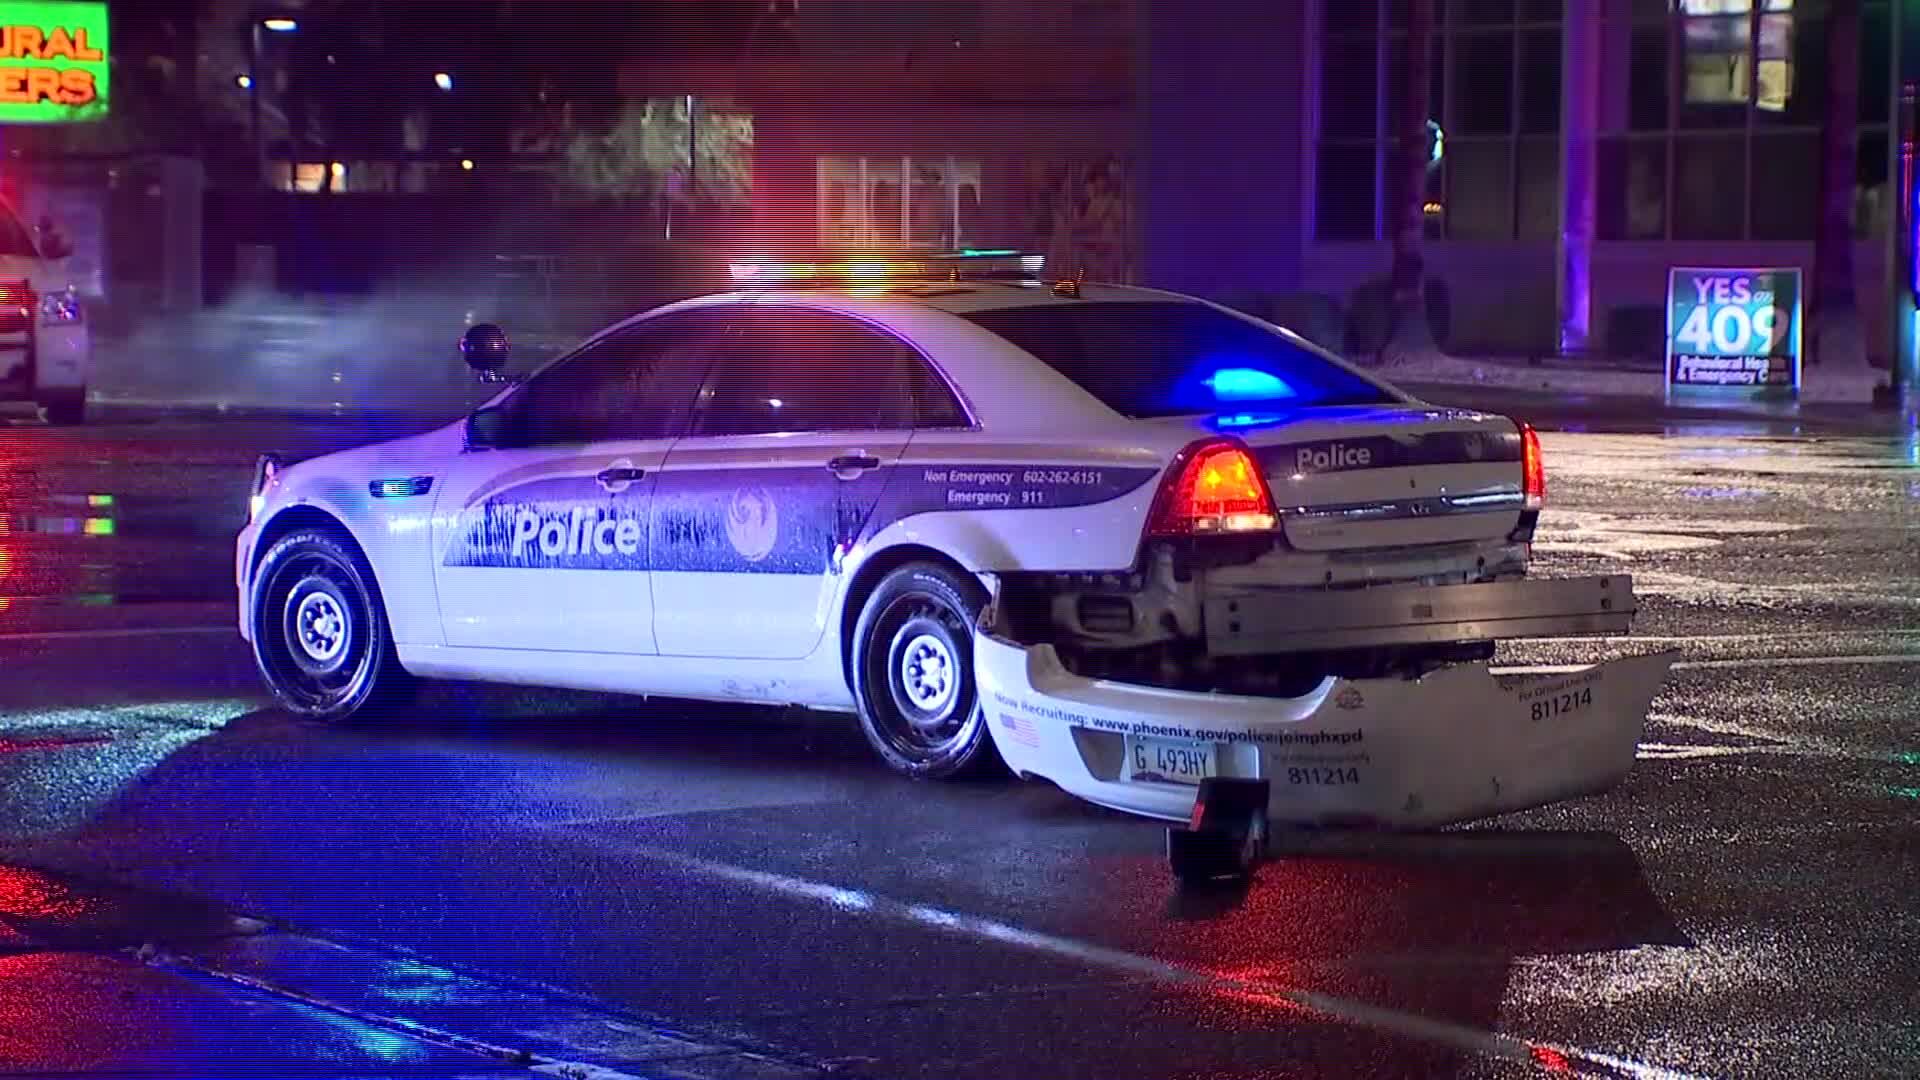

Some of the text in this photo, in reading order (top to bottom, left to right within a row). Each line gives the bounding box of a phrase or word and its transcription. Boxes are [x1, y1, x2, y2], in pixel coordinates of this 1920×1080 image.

[1693, 277, 1751, 305] YES
[1675, 304, 1790, 354] 409
[1689, 369, 1757, 384] Emergency
[1297, 444, 1371, 468] Police
[924, 470, 1102, 485] Non Emergency 602-262-6151
[947, 490, 1043, 505] Emergency 911
[511, 505, 641, 557] Police
[1021, 701, 1088, 728] Recruiting:
[1531, 687, 1593, 721] 811214
[1134, 743, 1208, 776] G 493HY
[1288, 767, 1360, 785] 811214
